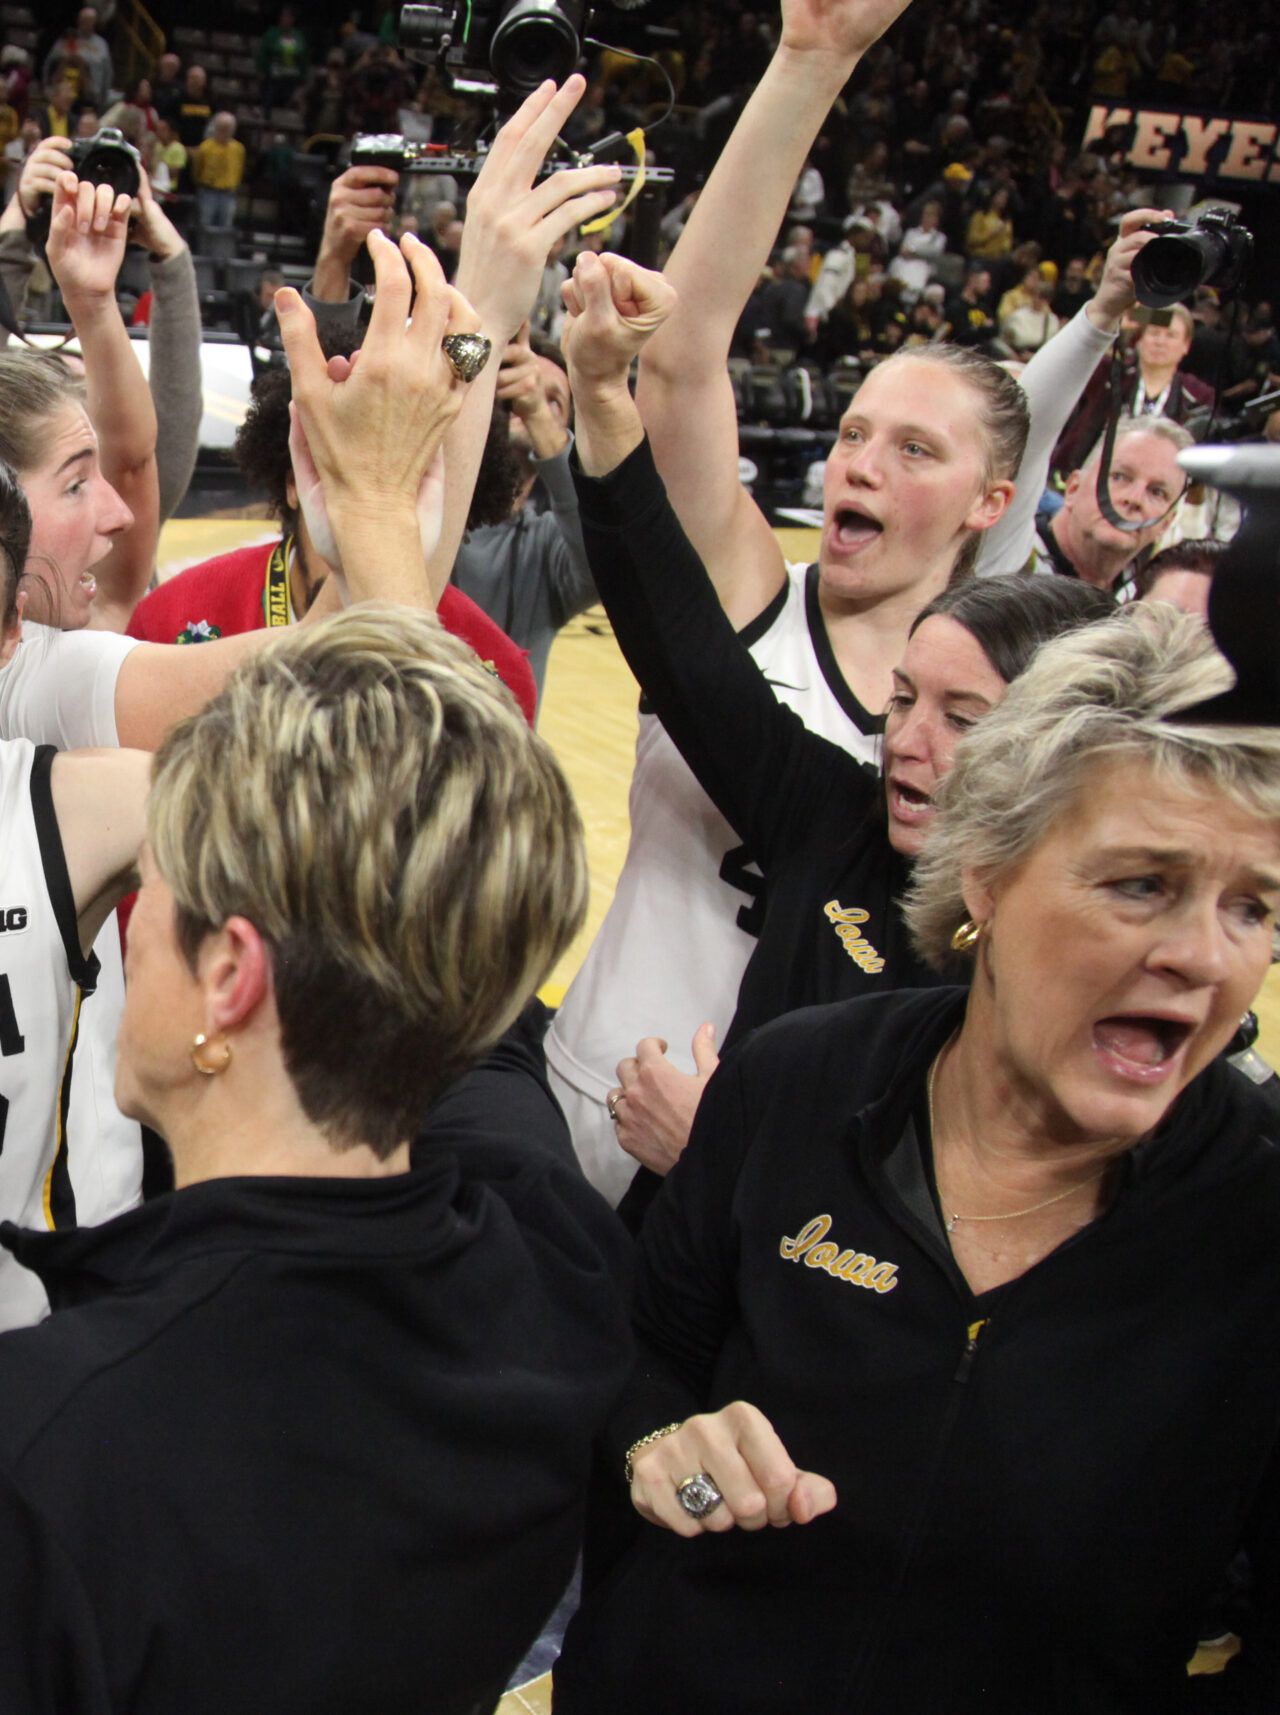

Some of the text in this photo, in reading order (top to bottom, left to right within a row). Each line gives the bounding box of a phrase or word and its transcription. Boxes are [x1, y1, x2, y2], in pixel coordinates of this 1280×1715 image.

[1082, 105, 1280, 182] KEYE
[823, 899, 886, 974] Iowa
[780, 1213, 900, 1294] Iowa
